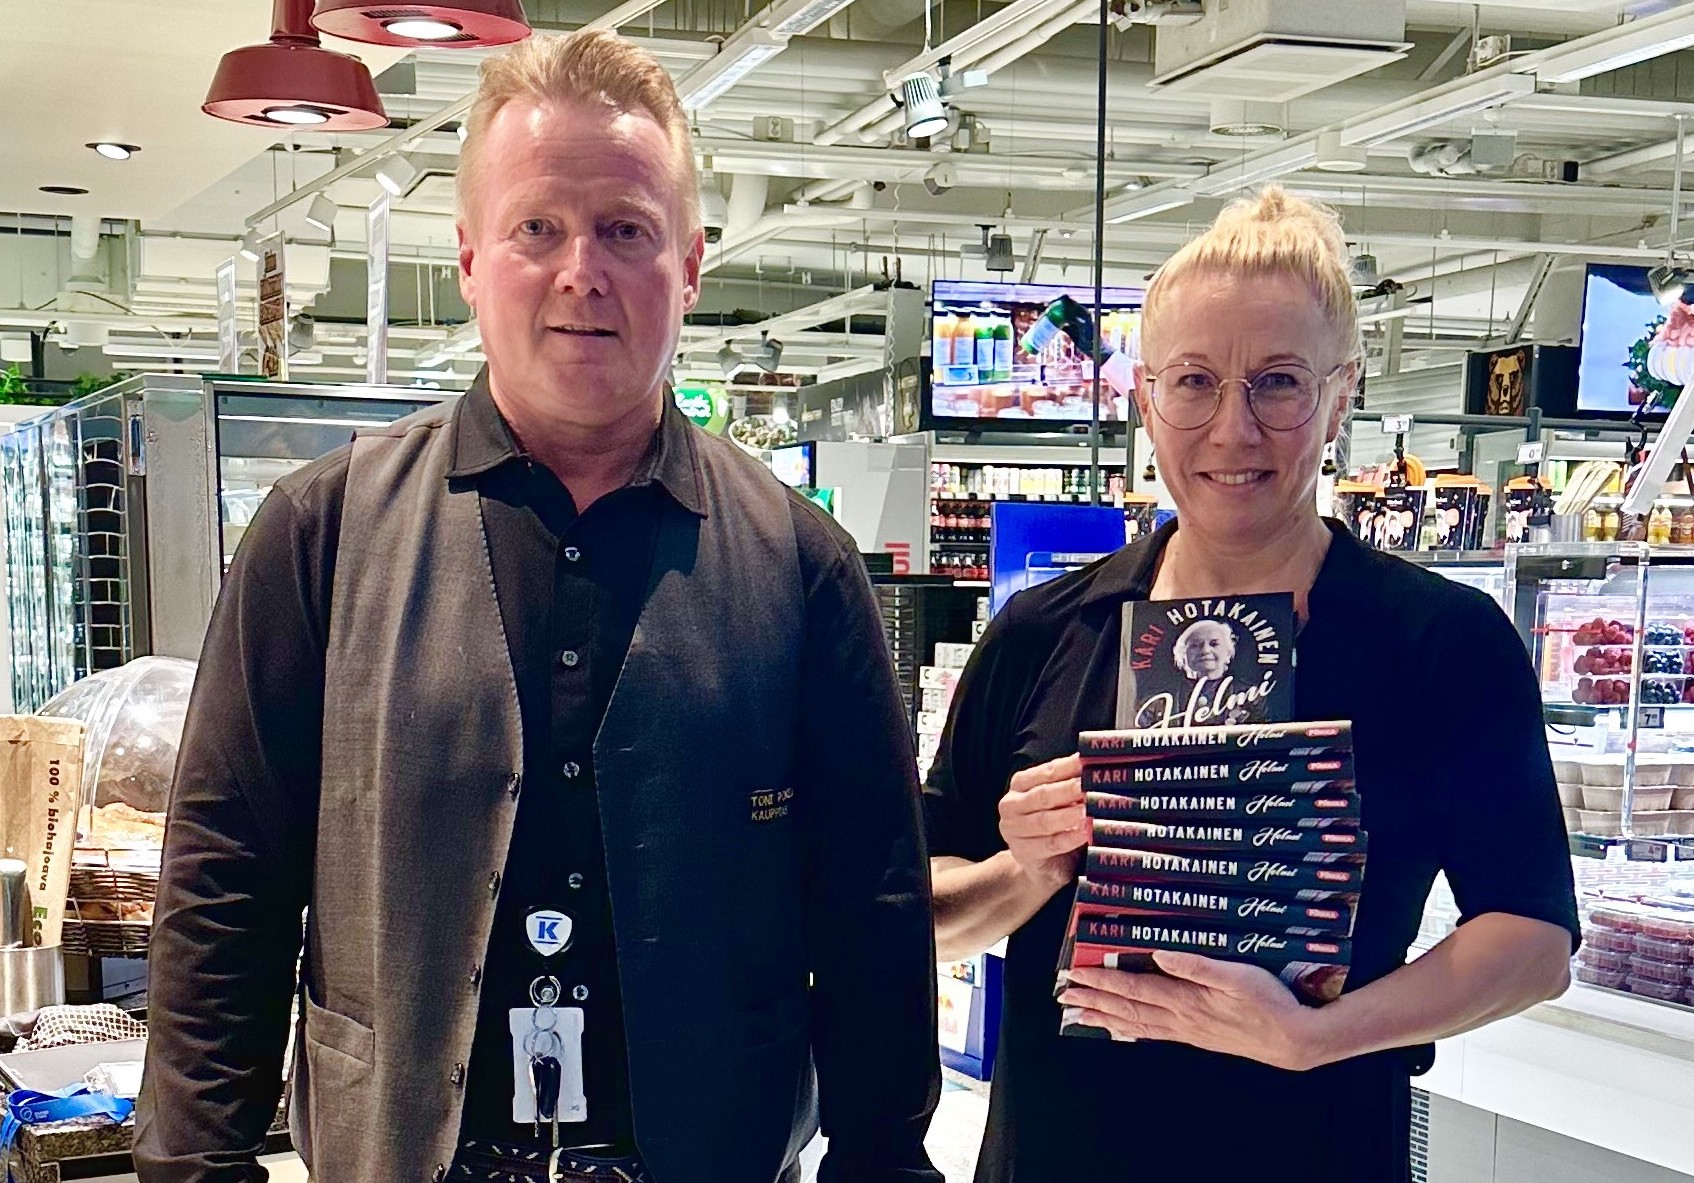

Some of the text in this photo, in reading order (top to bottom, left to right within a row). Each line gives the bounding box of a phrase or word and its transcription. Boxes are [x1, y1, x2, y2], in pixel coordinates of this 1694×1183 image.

[1131, 599, 1279, 671] KARI HOTAKAINEN
[1134, 670, 1277, 728] Helmi
[1091, 736, 1125, 749] KARI
[1132, 731, 1227, 748] HOTAKAINEN
[49, 759, 60, 786] 100
[1091, 769, 1127, 784] KARI
[1134, 764, 1229, 782] HOTAKAINEN
[1097, 798, 1132, 810] KARI
[1140, 796, 1236, 811] HOTAKAINEN
[1146, 825, 1243, 841] HOTAKAINEN
[1100, 854, 1135, 867] KARI
[1141, 856, 1238, 876] HOTAKAINEN
[1090, 884, 1126, 898] KARI
[1133, 887, 1228, 911] HOTAKAINEN
[33, 906, 48, 946] Eco
[537, 920, 559, 940] K
[1088, 922, 1125, 937] KARI
[1131, 925, 1227, 947] HOTAKAINEN
